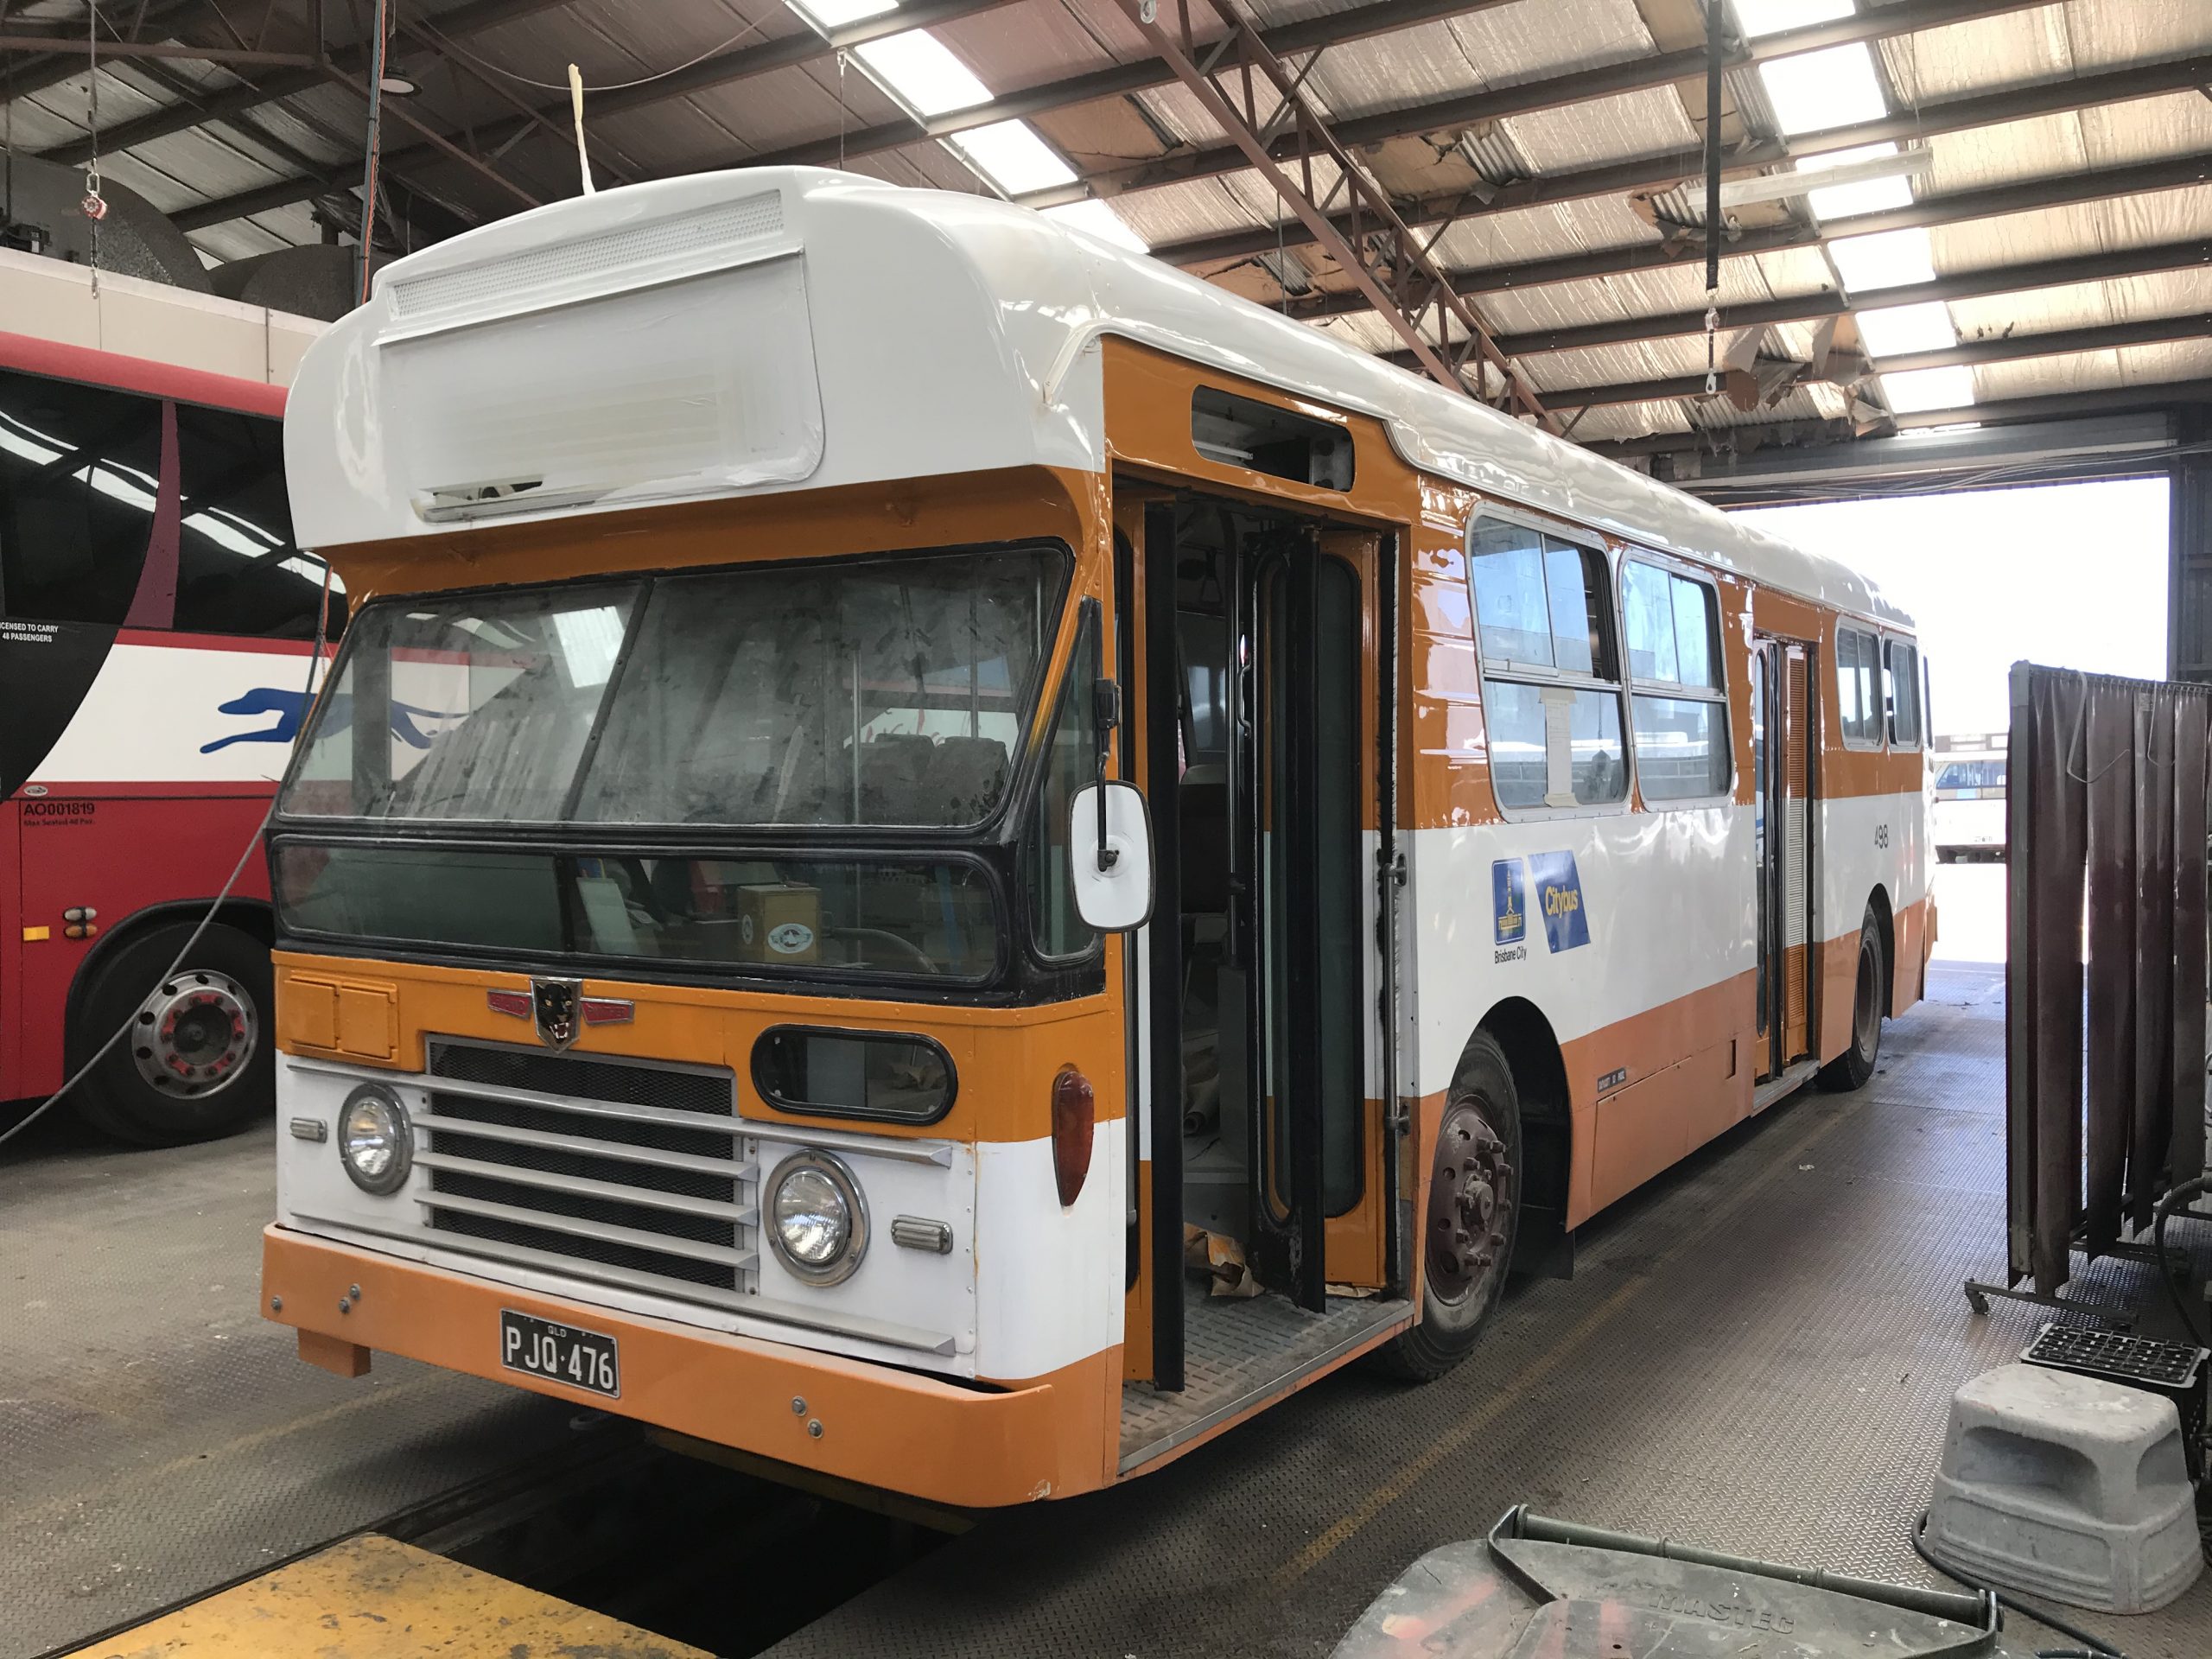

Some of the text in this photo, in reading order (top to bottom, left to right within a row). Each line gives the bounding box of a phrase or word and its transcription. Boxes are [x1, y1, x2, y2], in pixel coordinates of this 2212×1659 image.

[10, 632, 53, 642] PASSENGERS
[28, 623, 36, 632] TO
[37, 624, 59, 633] CARRY
[1874, 824, 1888, 849] 498
[1545, 885, 1579, 918] Citybus
[1494, 946, 1528, 964] Brisbane City
[547, 1325, 568, 1338] QLD
[1648, 1592, 1795, 1635] MASTEC
